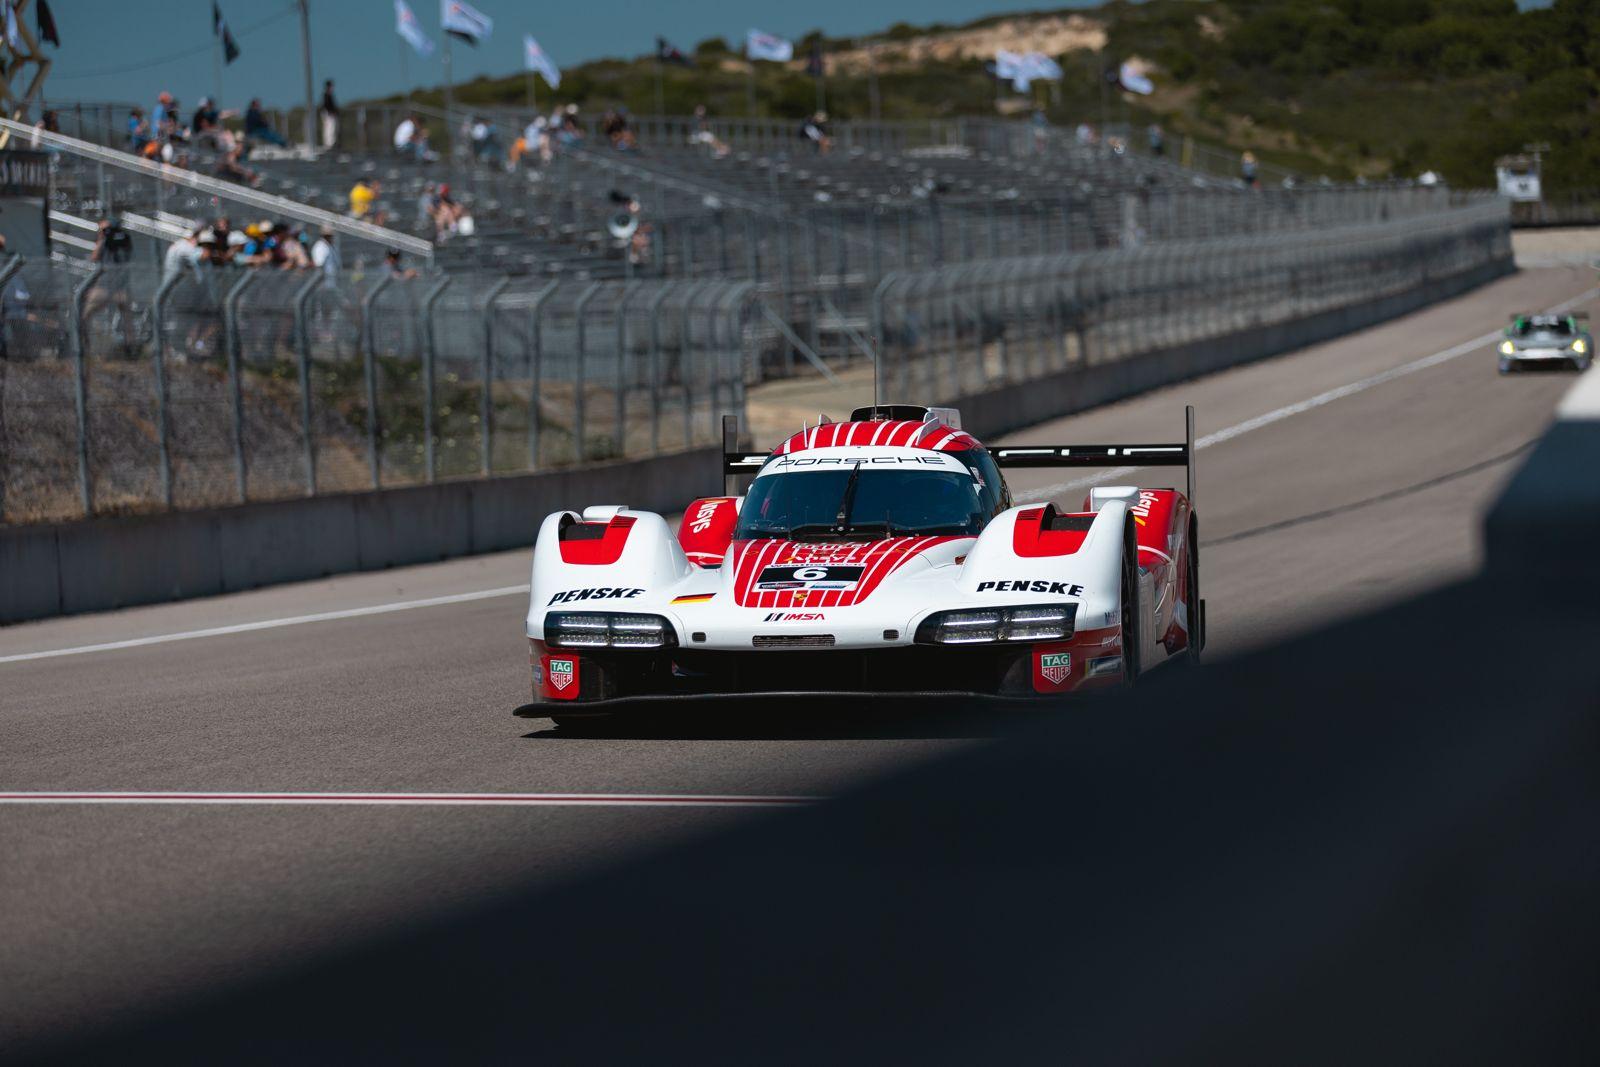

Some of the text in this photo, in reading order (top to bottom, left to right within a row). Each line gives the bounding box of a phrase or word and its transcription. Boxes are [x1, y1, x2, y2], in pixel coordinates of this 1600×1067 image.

[775, 456, 946, 468] PORSCHE
[793, 567, 829, 581] 6
[976, 580, 1085, 597] PENSKE
[546, 587, 647, 607] PENSKE
[783, 613, 826, 621] IMSA
[551, 661, 571, 672] TAG
[1044, 655, 1069, 666] TAG
[551, 672, 571, 688] HEUER
[1043, 666, 1070, 682] HEUER
